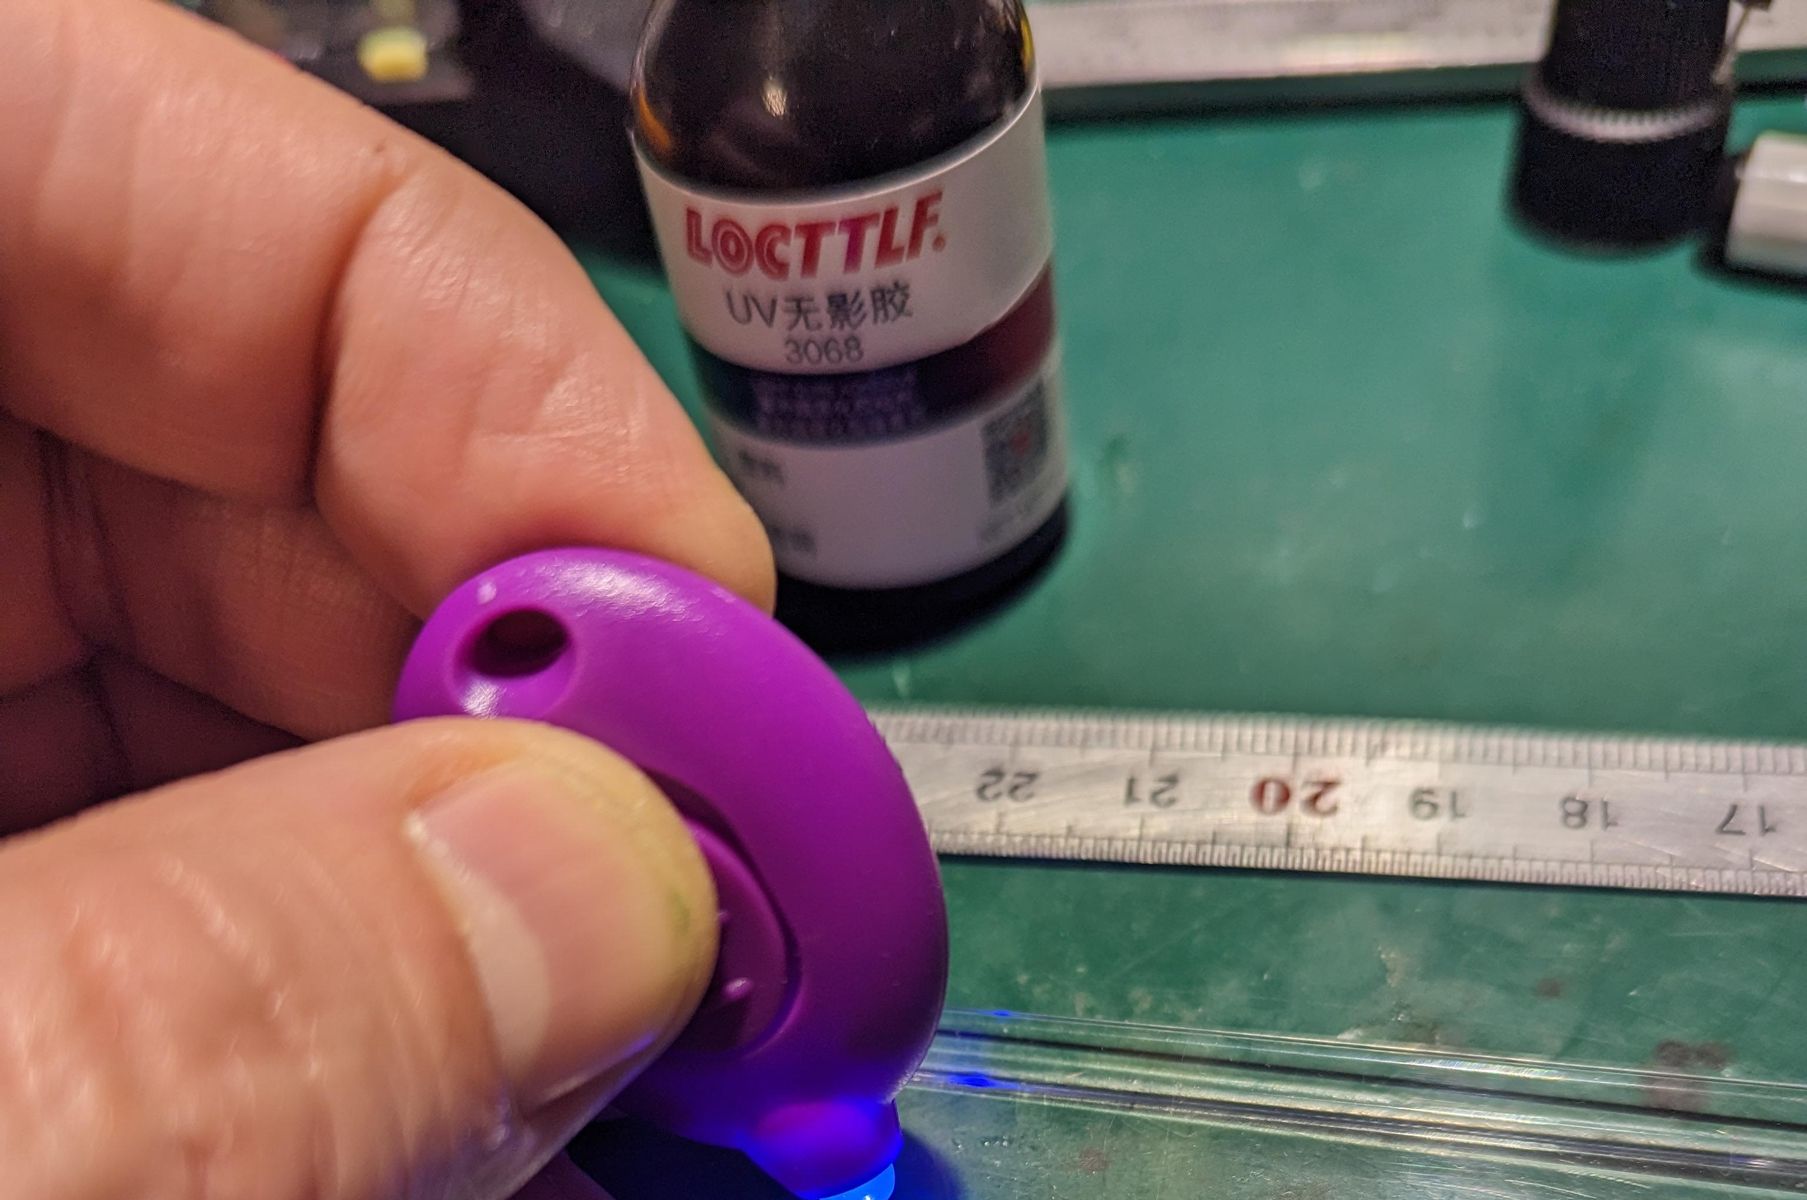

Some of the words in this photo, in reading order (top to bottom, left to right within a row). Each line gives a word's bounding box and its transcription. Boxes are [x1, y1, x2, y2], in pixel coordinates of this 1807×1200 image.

[784, 335, 865, 366] 3068
[975, 766, 1038, 803] 22
[1123, 772, 1180, 806] 21
[1249, 776, 1341, 816] 20
[1408, 786, 1466, 821] 19
[1561, 795, 1620, 831] 18
[1716, 802, 1777, 838] 17
